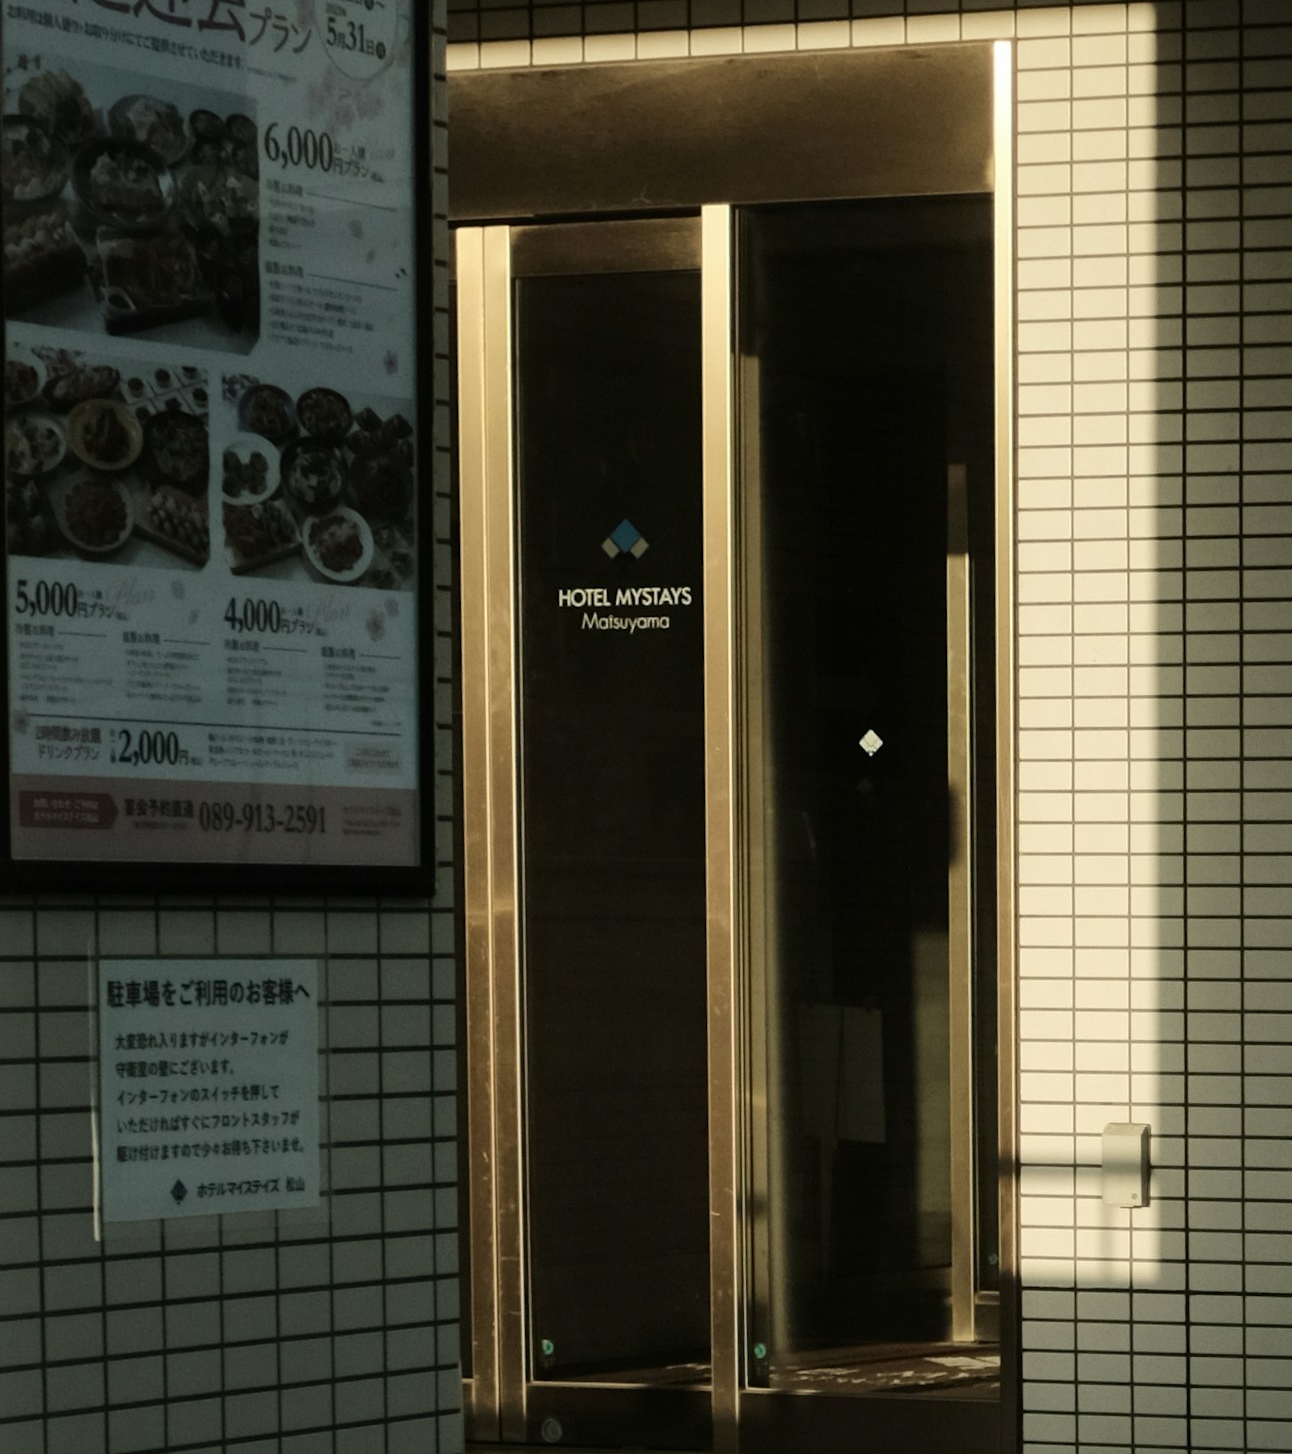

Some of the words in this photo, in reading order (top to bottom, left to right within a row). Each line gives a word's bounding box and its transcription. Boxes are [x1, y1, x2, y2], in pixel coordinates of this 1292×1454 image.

[558, 587, 611, 608] HOTEL
[615, 585, 693, 607] MYSTAYS
[581, 612, 671, 634] Matsuyama
[198, 800, 327, 835] 089-913-2591
[107, 977, 311, 1008] 駐車場をご利用のお客様へ
[117, 1084, 281, 1106] インターフォンのスイッチを押して
[117, 1111, 301, 1134] いただければすぐにフロントスタッフが
